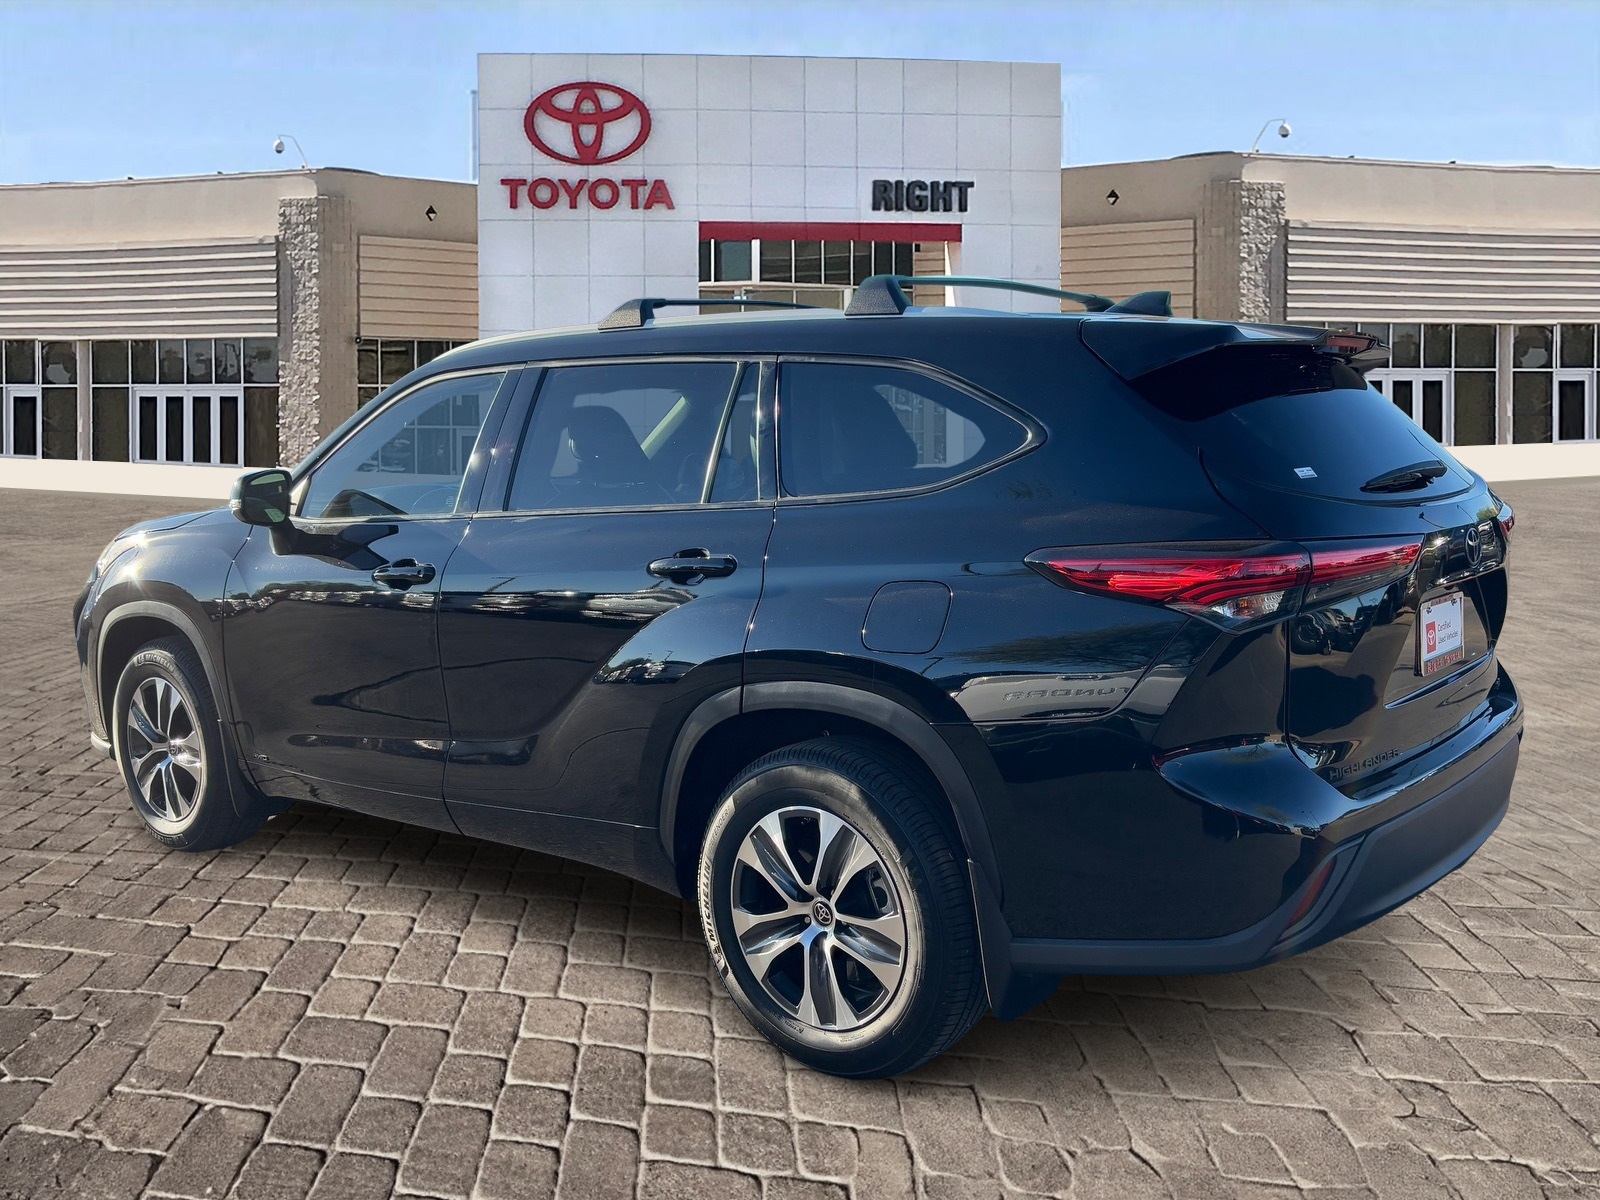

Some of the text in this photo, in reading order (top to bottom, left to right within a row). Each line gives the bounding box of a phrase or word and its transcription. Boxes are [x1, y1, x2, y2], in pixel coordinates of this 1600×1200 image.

[500, 178, 676, 211] TOYOTA
[871, 179, 976, 213] RIGHT
[1437, 620, 1452, 632] Certified
[145, 653, 175, 672] MICHELIN
[1330, 748, 1399, 779] HIGHLANDER
[703, 861, 716, 942] MICHELIN
